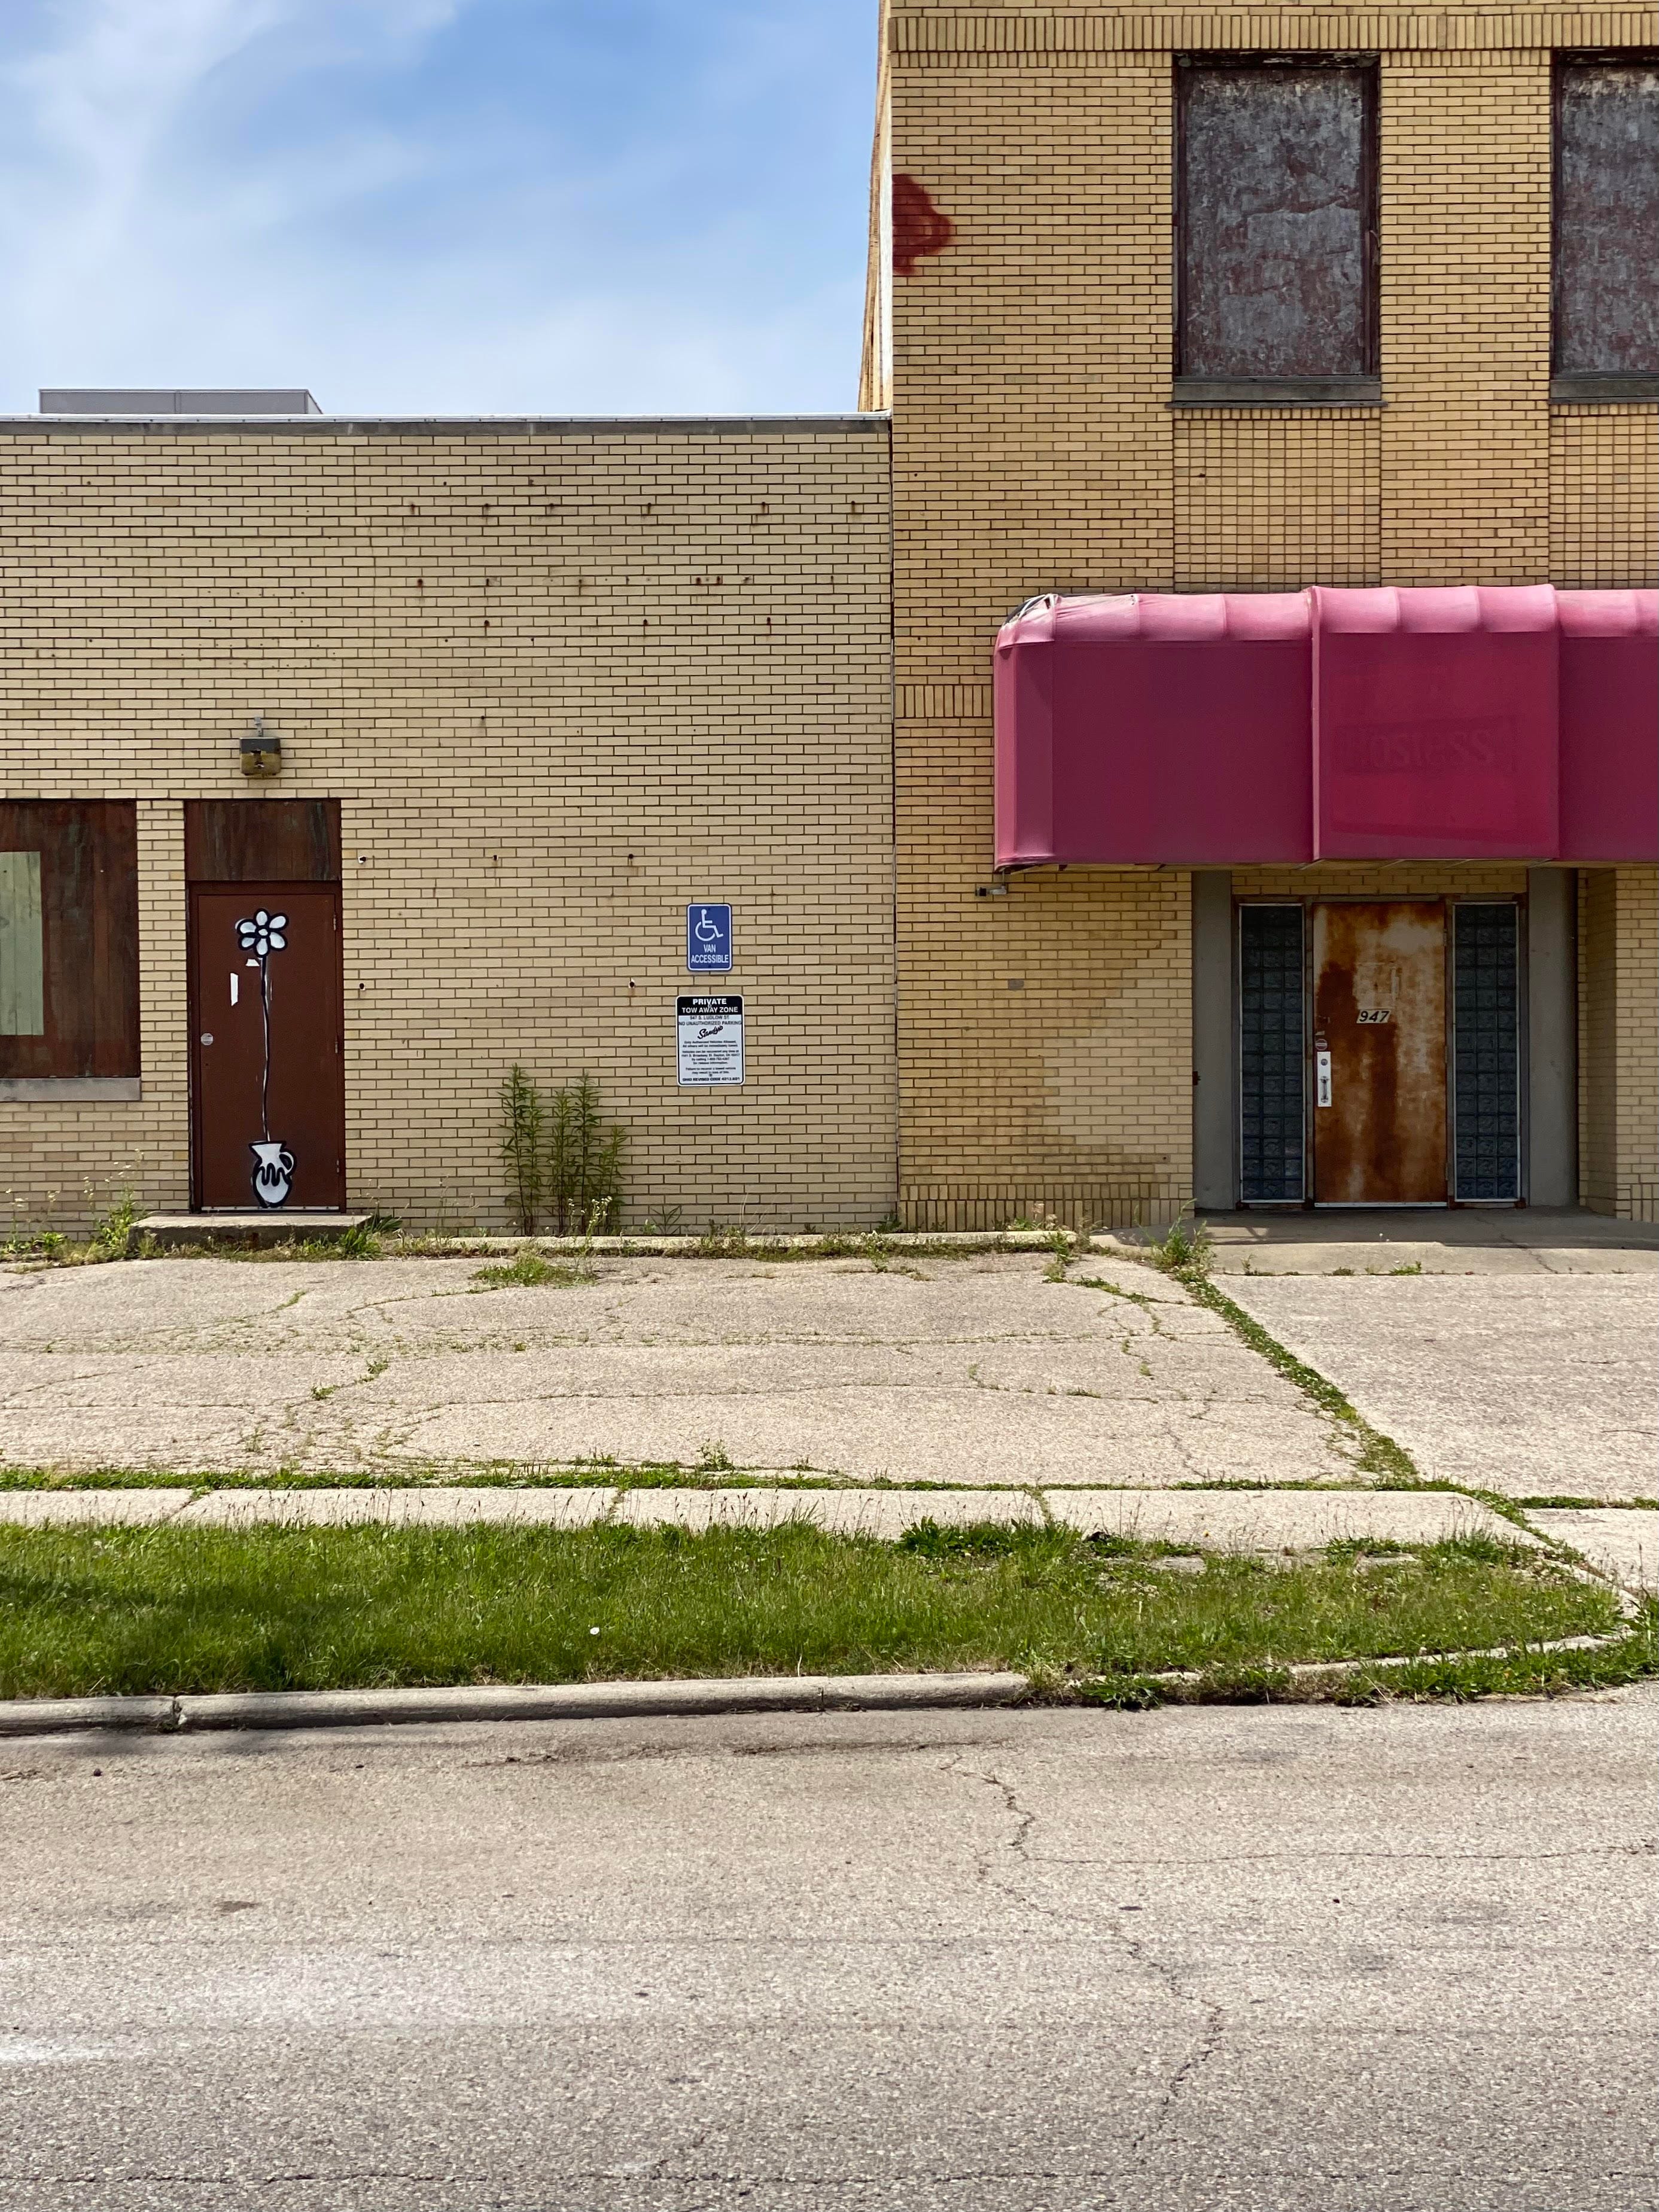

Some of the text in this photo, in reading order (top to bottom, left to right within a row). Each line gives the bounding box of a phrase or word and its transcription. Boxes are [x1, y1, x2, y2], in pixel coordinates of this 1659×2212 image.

[704, 944, 716, 953] VAN
[691, 954, 729, 963] ACCESSIBLE
[1359, 1011, 1389, 1022] 947
